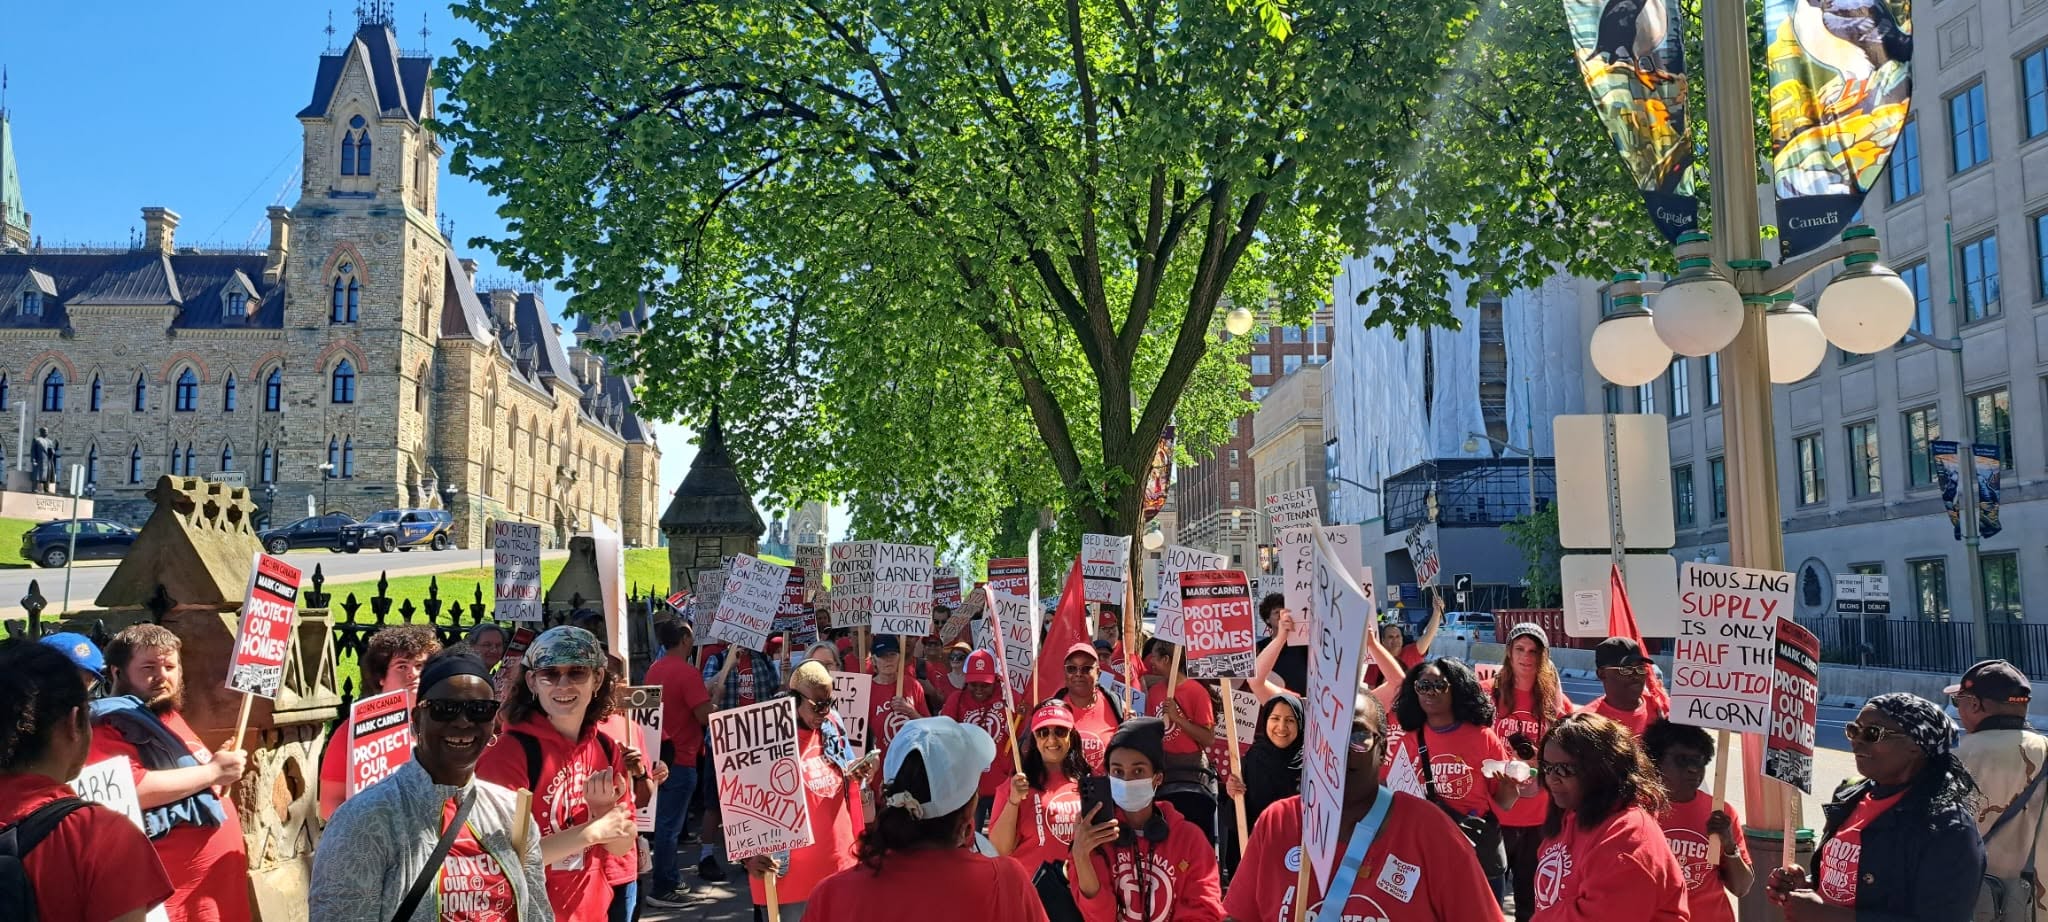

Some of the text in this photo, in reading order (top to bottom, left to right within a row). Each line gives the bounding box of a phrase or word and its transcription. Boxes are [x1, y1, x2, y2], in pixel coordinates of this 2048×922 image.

[1789, 213, 1838, 230] Canada
[1267, 488, 1313, 505] NO RENT
[1268, 499, 1312, 514] CONTROL?
[1271, 508, 1319, 524] NO TENANT
[496, 523, 539, 538] NO RENT
[1084, 534, 1100, 546] BED
[496, 552, 540, 566] NO TENANT
[832, 544, 877, 559] NO REN
[880, 545, 930, 564] MARK
[1168, 548, 1222, 570] HOMES
[280, 564, 297, 580] CANADA
[496, 568, 540, 580] PROTECTION?
[736, 556, 750, 568] NO
[754, 560, 787, 579] RENT
[876, 566, 932, 583] CARNEY
[1100, 566, 1122, 577] RENT
[258, 576, 296, 598] MARK CARNEY
[727, 580, 742, 592] NO
[732, 570, 783, 588] CONTROL?
[832, 574, 846, 584] NO
[992, 576, 1028, 588] PROTECT
[1690, 567, 1789, 594] HOUSING
[497, 584, 509, 598] NO
[786, 586, 804, 595] TECT
[832, 583, 874, 598] PROTECTI
[876, 584, 932, 599] PROTECT
[1186, 586, 1245, 596] MARK CARNEY
[248, 597, 293, 625] PROTECT
[502, 604, 535, 618] ACORN
[777, 604, 803, 614] OMES
[832, 595, 873, 614] NO MON
[873, 600, 930, 616] OUR HOMES
[1184, 600, 1249, 620] PROTECT
[1682, 592, 1778, 621] SUPPLY
[716, 606, 770, 632] NO MONEY!
[838, 610, 872, 626] ACORN
[881, 618, 926, 635] ACORN
[250, 618, 272, 638] OUR
[1010, 624, 1032, 644] NO
[1192, 620, 1223, 634] OUR
[1681, 620, 1774, 642] IS ONLY
[720, 626, 758, 649] ACORN
[1186, 630, 1252, 652] HOMES
[240, 632, 285, 662] HOMES
[1676, 640, 1730, 665] HALF
[1780, 643, 1800, 662] MARK
[1775, 669, 1818, 706] PROTECT
[376, 695, 402, 710] CANADA
[876, 695, 914, 716] ACN
[1780, 694, 1804, 720] OUR
[1688, 698, 1764, 727] ACORN
[356, 710, 406, 736] MARK CARNEY
[711, 700, 795, 756] RENTERS
[1771, 714, 1816, 750] HOMES
[354, 728, 409, 766] PROTECT
[1082, 738, 1101, 750] TECT
[721, 741, 795, 773] ARE THE
[360, 756, 388, 780] OUR
[1430, 762, 1467, 776] ROTECT
[78, 769, 122, 802] ARK
[1421, 782, 1453, 794] HMES
[720, 775, 806, 834] MAJORITY!
[1056, 814, 1071, 824] OUR
[726, 820, 752, 837] VOTE
[1052, 823, 1074, 836] HOM
[728, 836, 754, 854] LIKE
[444, 854, 501, 877] ROTEC
[1392, 859, 1416, 873] ACORN
[444, 876, 470, 891] OUR
[1382, 878, 1408, 896] HOUSING
[440, 890, 492, 914] HOMES
[1389, 888, 1408, 900] RIGHT
